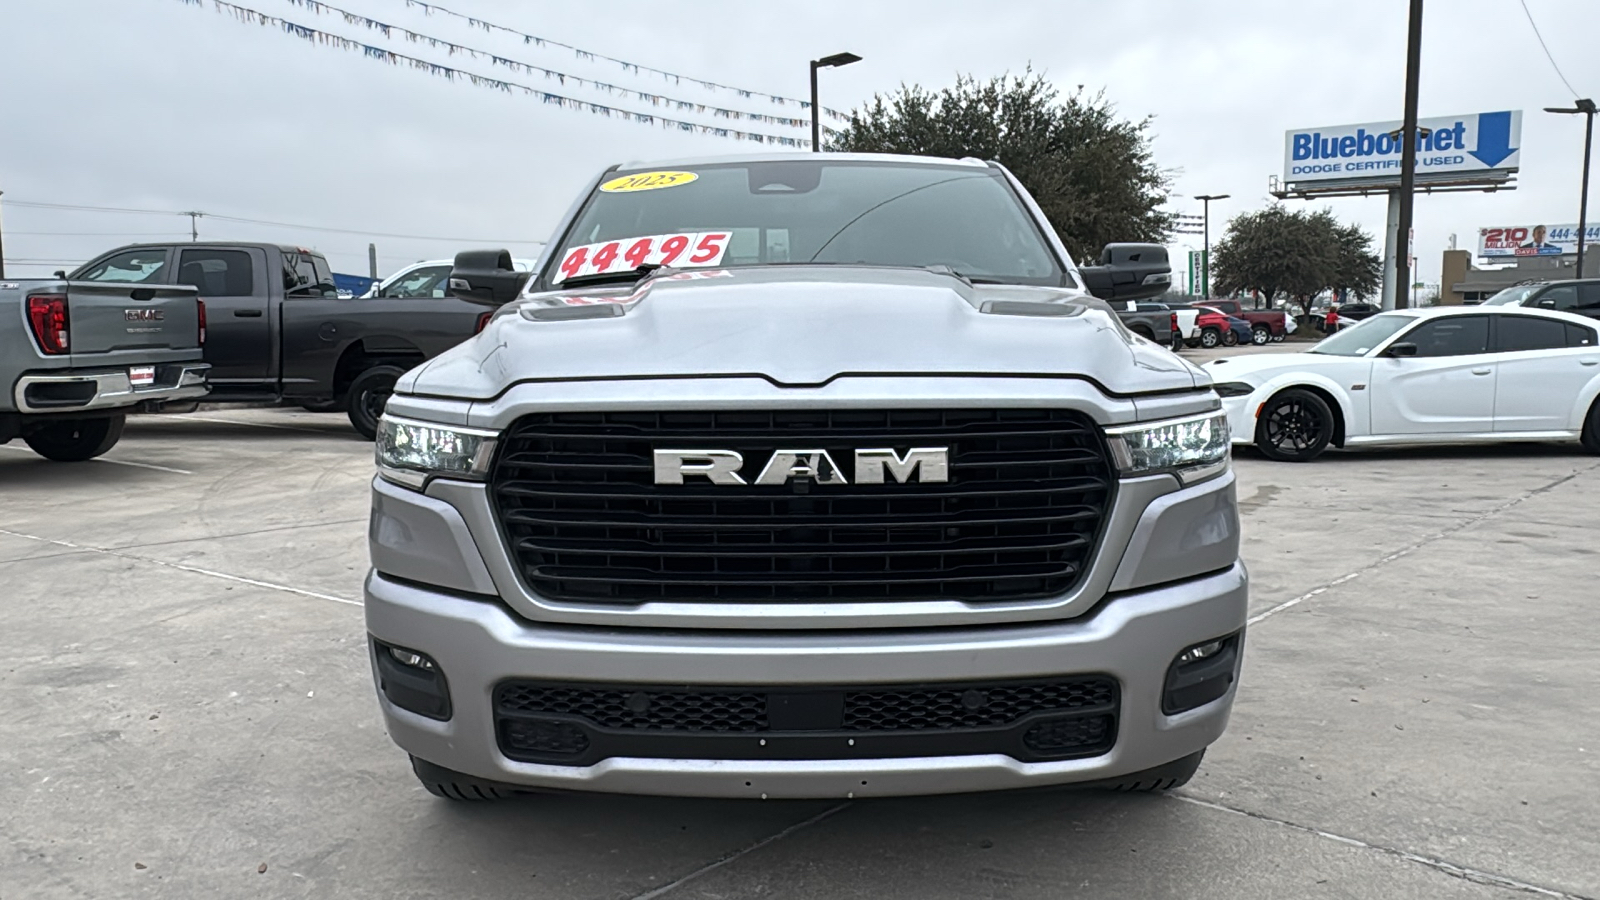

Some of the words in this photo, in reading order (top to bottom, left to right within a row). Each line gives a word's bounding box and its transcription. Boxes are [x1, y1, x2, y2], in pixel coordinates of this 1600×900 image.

[1292, 164, 1342, 175] DODGE
[1345, 159, 1419, 171] CERTIFI
[1423, 155, 1465, 167] USED
[612, 174, 684, 190] 2025
[1481, 228, 1528, 242] $210
[1550, 227, 1600, 239] 444-444
[1485, 241, 1522, 249] MILLION
[561, 234, 727, 278] 44495
[125, 309, 164, 321] GMC
[653, 447, 949, 485] RAM
